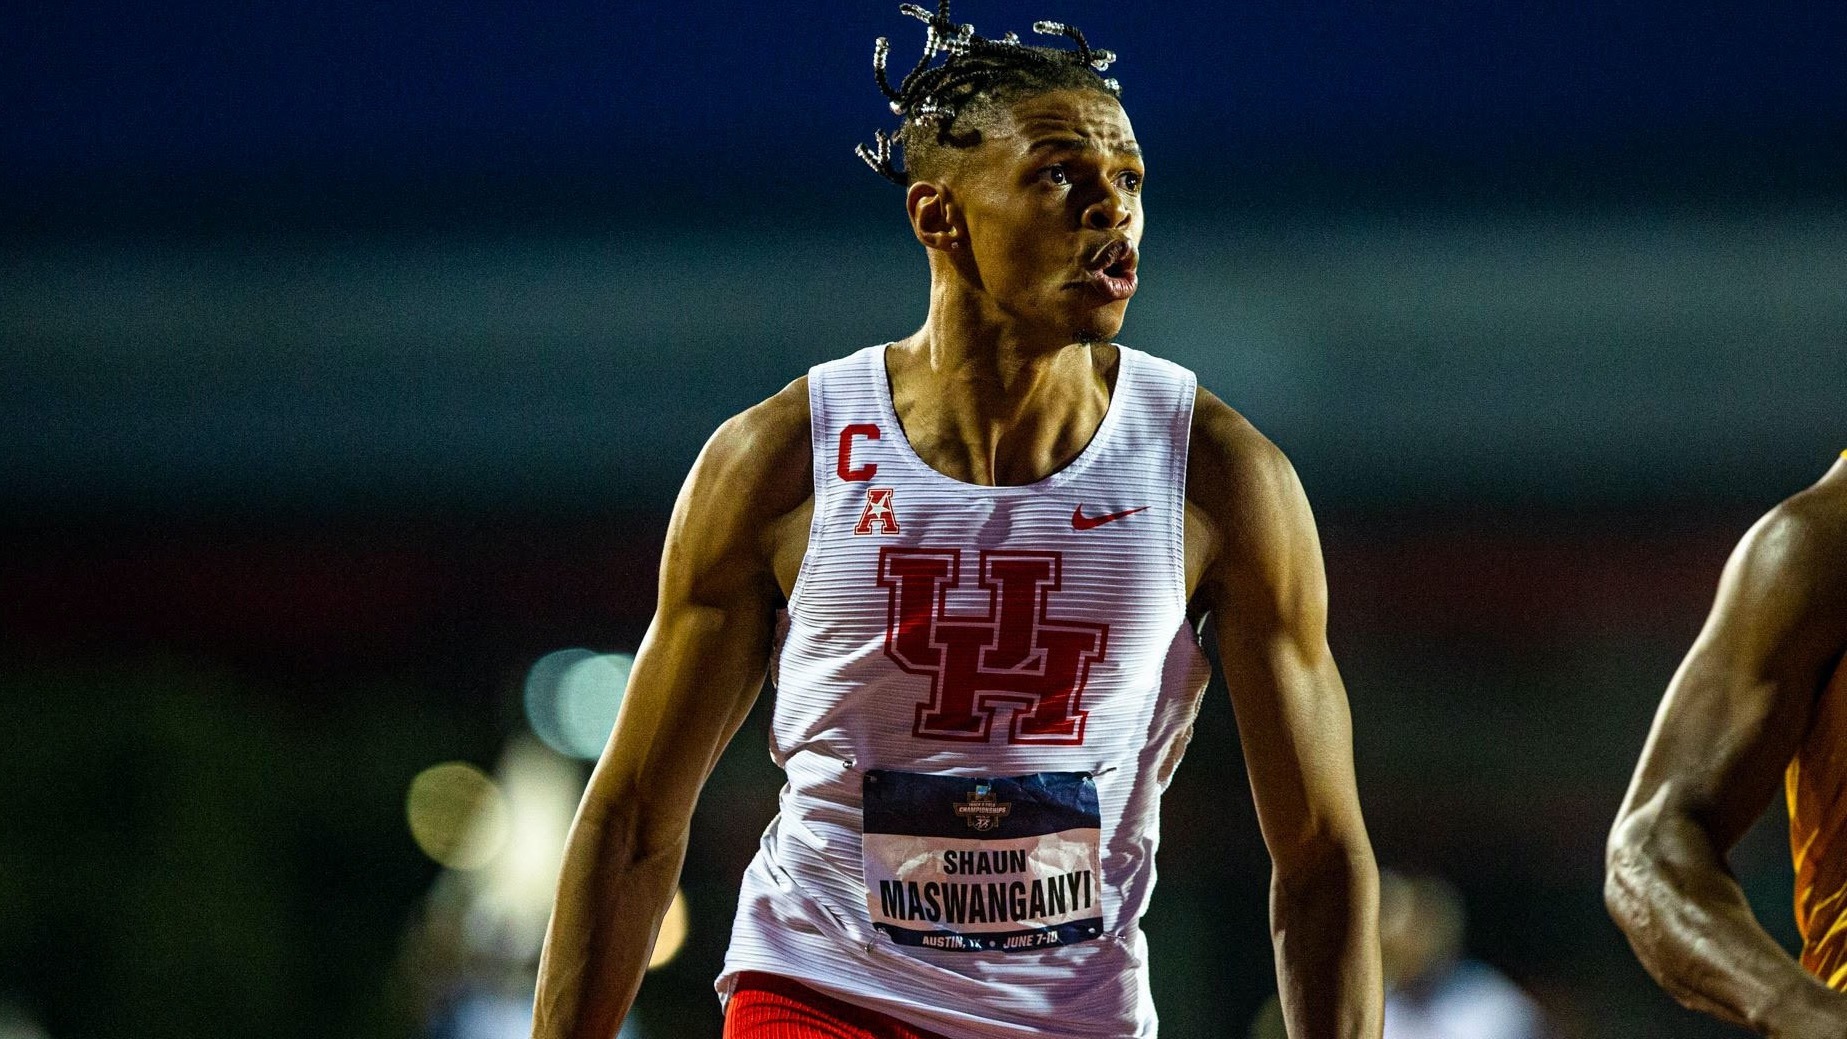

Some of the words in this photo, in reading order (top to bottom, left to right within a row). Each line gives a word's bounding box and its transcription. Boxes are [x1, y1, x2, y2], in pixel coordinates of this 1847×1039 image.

[836, 424, 881, 482] C
[854, 488, 900, 536] A
[943, 850, 1026, 875] SHAUN
[880, 870, 1091, 924] MASWANGANYI
[922, 935, 966, 949] AUSTIN,
[1003, 935, 1034, 949] JUNE
[1036, 931, 1058, 945] 7-10
